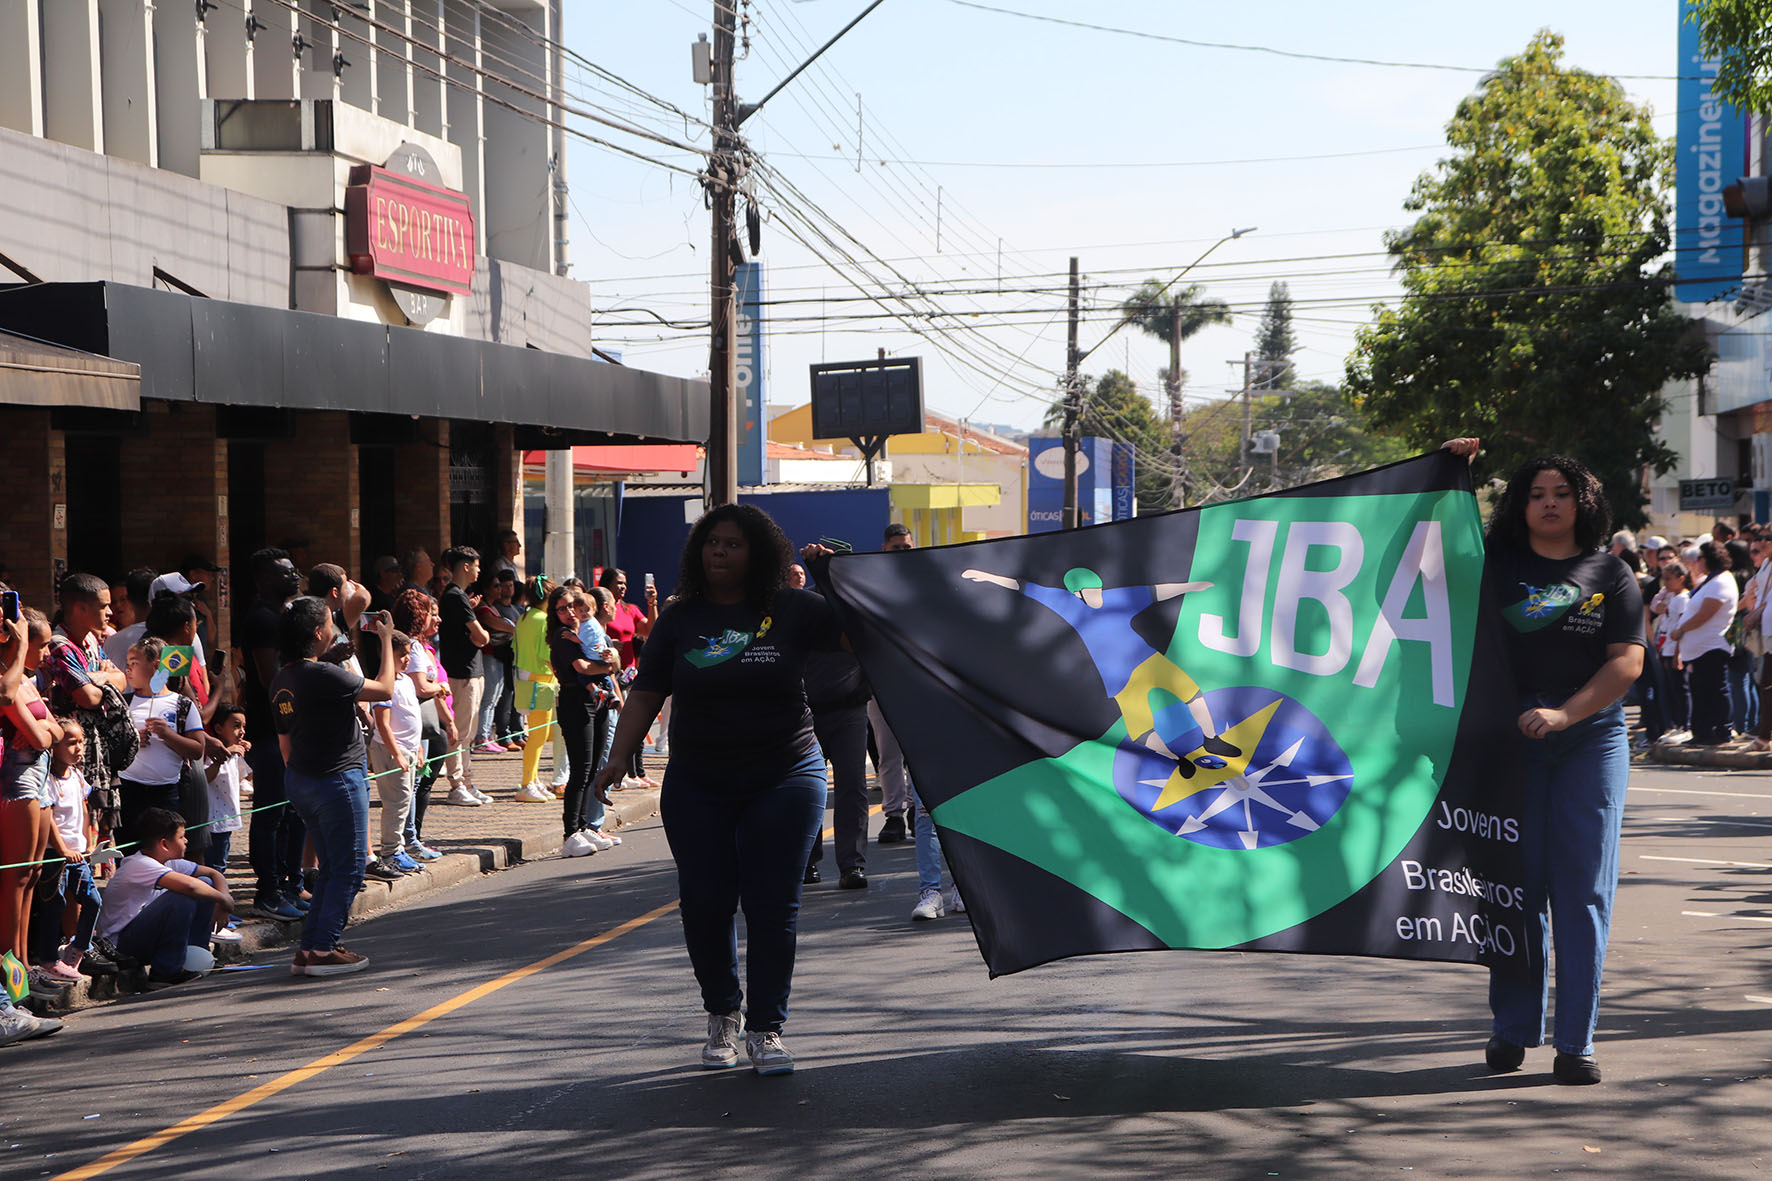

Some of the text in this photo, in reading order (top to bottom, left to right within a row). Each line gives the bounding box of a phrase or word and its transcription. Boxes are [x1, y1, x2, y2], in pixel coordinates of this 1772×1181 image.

[376, 197, 468, 270] ESPORTIVA
[410, 293, 428, 315] BAR
[1682, 482, 1730, 497] BETO
[1030, 510, 1060, 521] ÓTICAS
[1543, 585, 1575, 604] JBA
[1198, 519, 1455, 708] JBA
[722, 630, 750, 645] JBA
[1437, 801, 1519, 843] Jovens
[1401, 860, 1524, 911] Brasileiros
[1396, 915, 1443, 942] em
